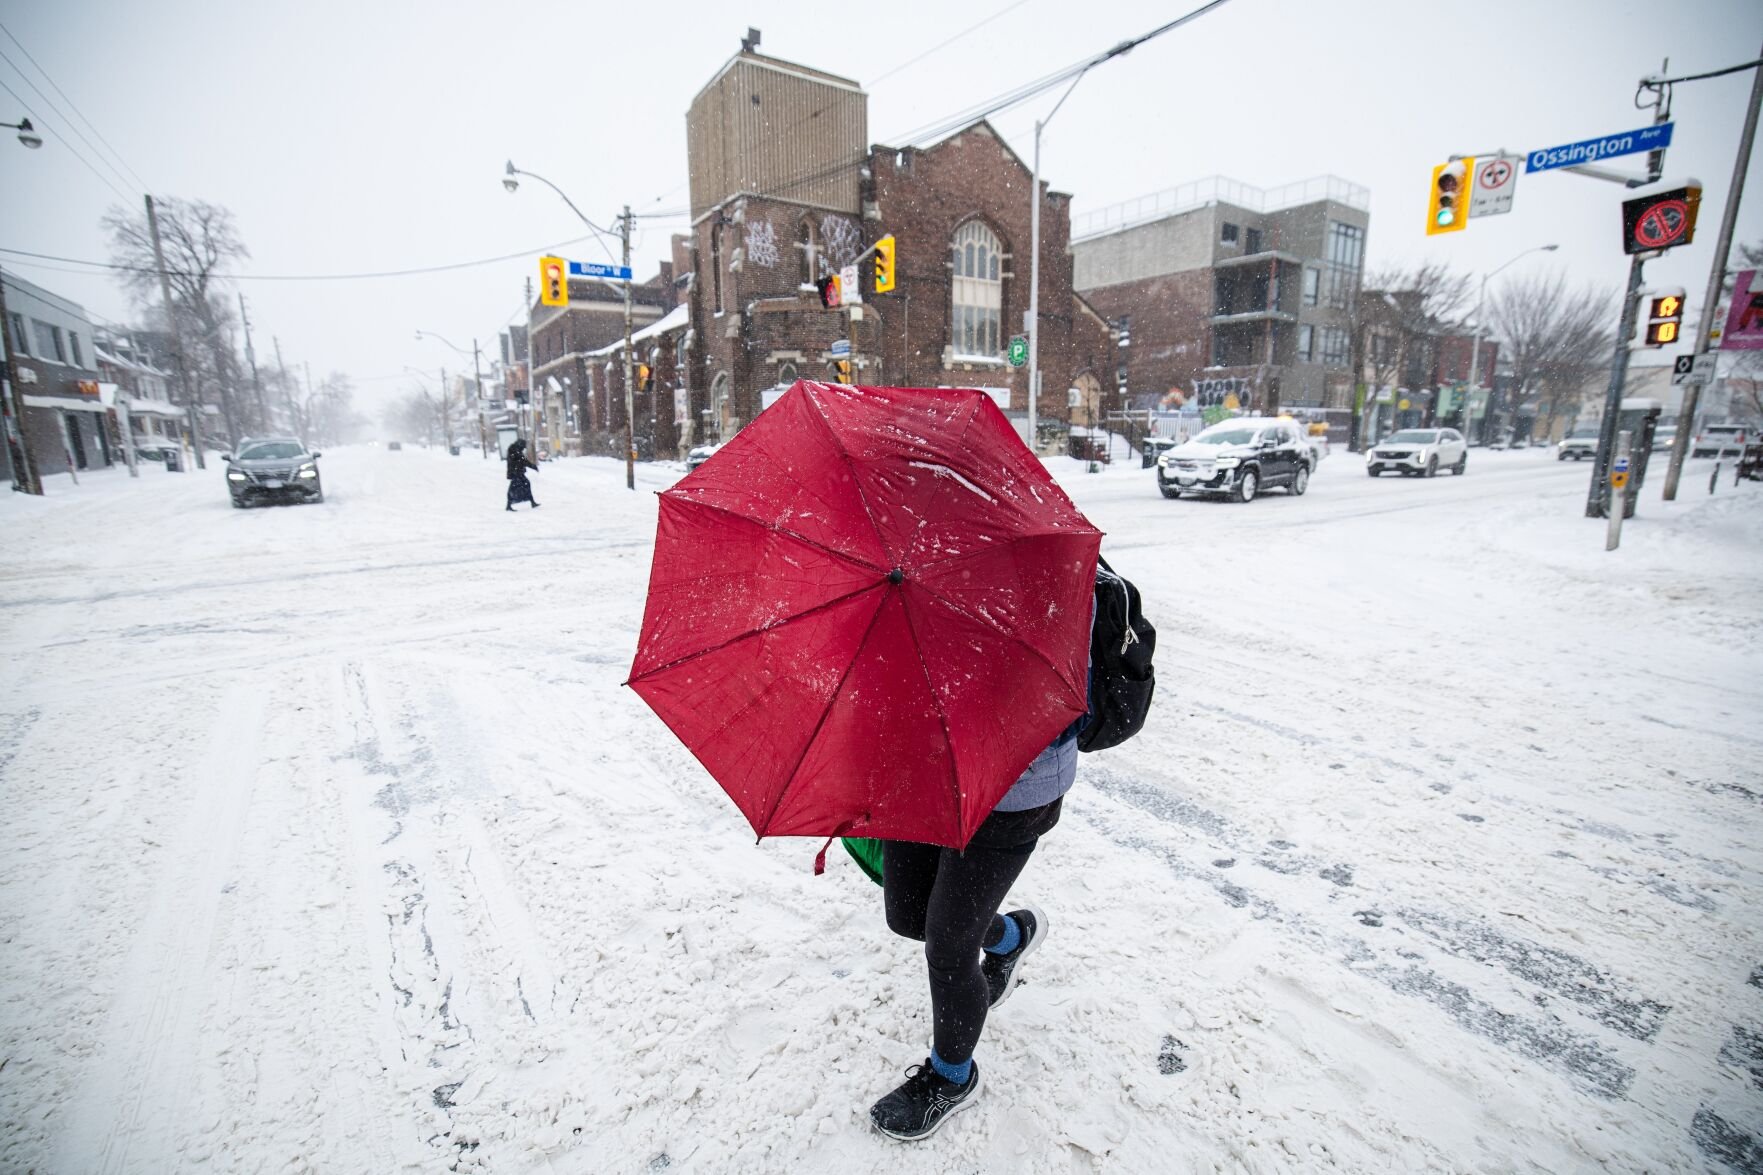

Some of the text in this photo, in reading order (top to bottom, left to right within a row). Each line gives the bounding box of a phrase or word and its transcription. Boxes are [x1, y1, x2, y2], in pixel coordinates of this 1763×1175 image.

[1532, 128, 1662, 168] Ossington Ave
[1014, 344, 1024, 359] P
